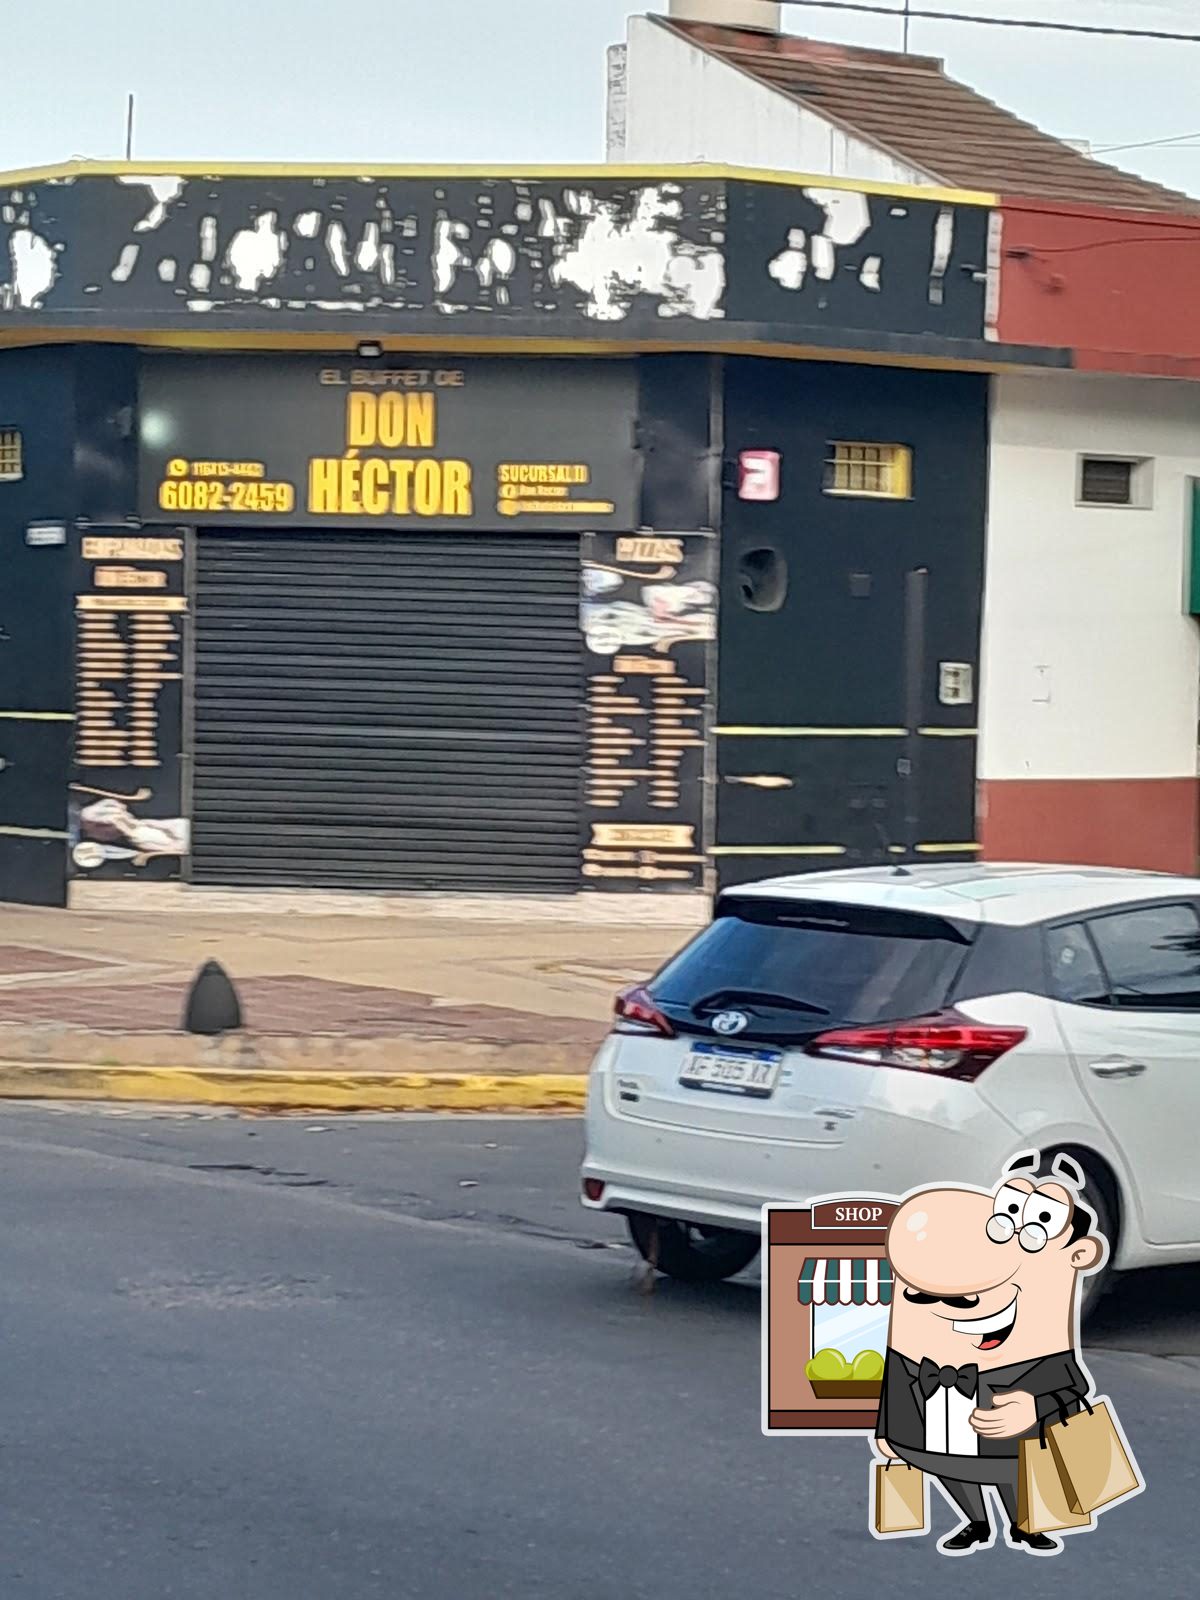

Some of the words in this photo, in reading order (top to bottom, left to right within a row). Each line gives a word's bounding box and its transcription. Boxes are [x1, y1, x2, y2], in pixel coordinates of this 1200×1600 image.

[319, 369, 347, 385] EL
[350, 369, 431, 386] BUFFET
[434, 370, 465, 386] DE
[347, 390, 435, 447] DON
[159, 480, 294, 512] 6082-2459
[308, 448, 472, 516] HÉCTOR
